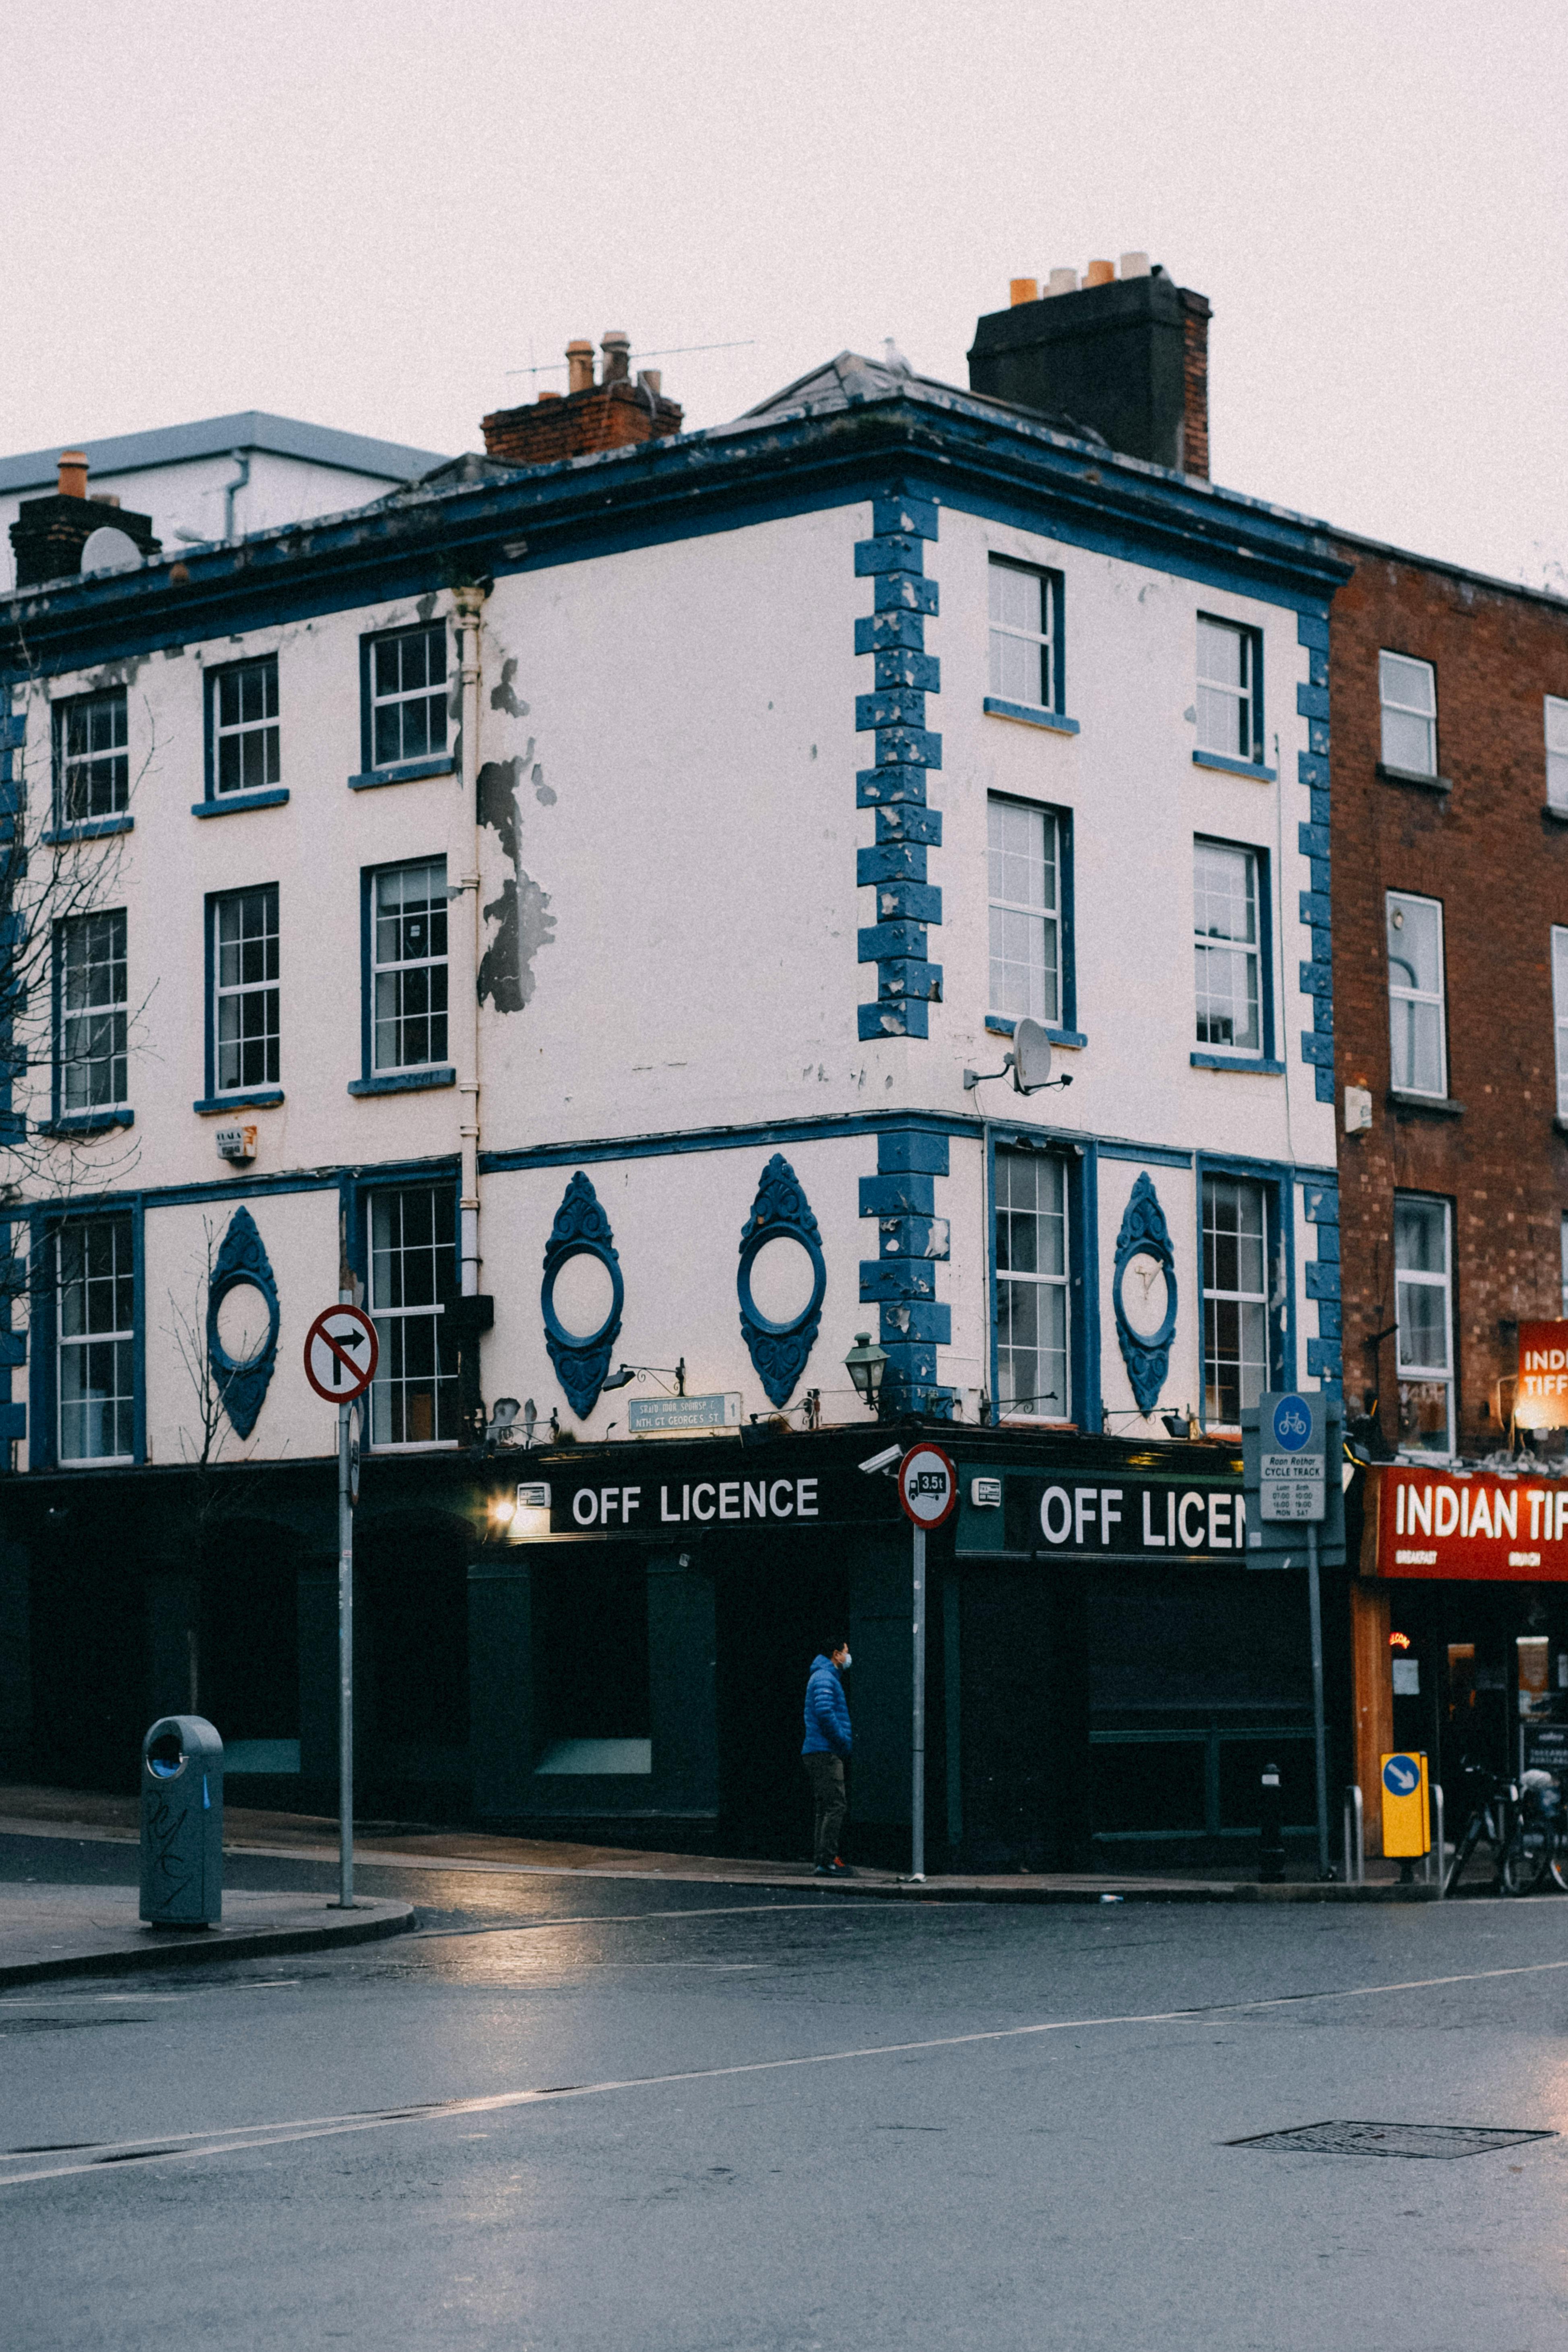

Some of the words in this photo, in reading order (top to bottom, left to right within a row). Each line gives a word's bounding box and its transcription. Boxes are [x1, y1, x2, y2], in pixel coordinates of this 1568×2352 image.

[731, 1403, 735, 1417] 1
[1270, 1457, 1288, 1465] Raon
[1291, 1457, 1315, 1465] Rothar
[1265, 1467, 1290, 1477] CYCLE
[1293, 1467, 1320, 1477] TRACK
[922, 1476, 943, 1489] 3.5t
[573, 1487, 641, 1525] OFF
[661, 1478, 818, 1521] LICENCE
[1040, 1486, 1123, 1544] OFF
[1396, 1484, 1518, 1540] INDIAN
[1526, 1490, 1568, 1541] TIF
